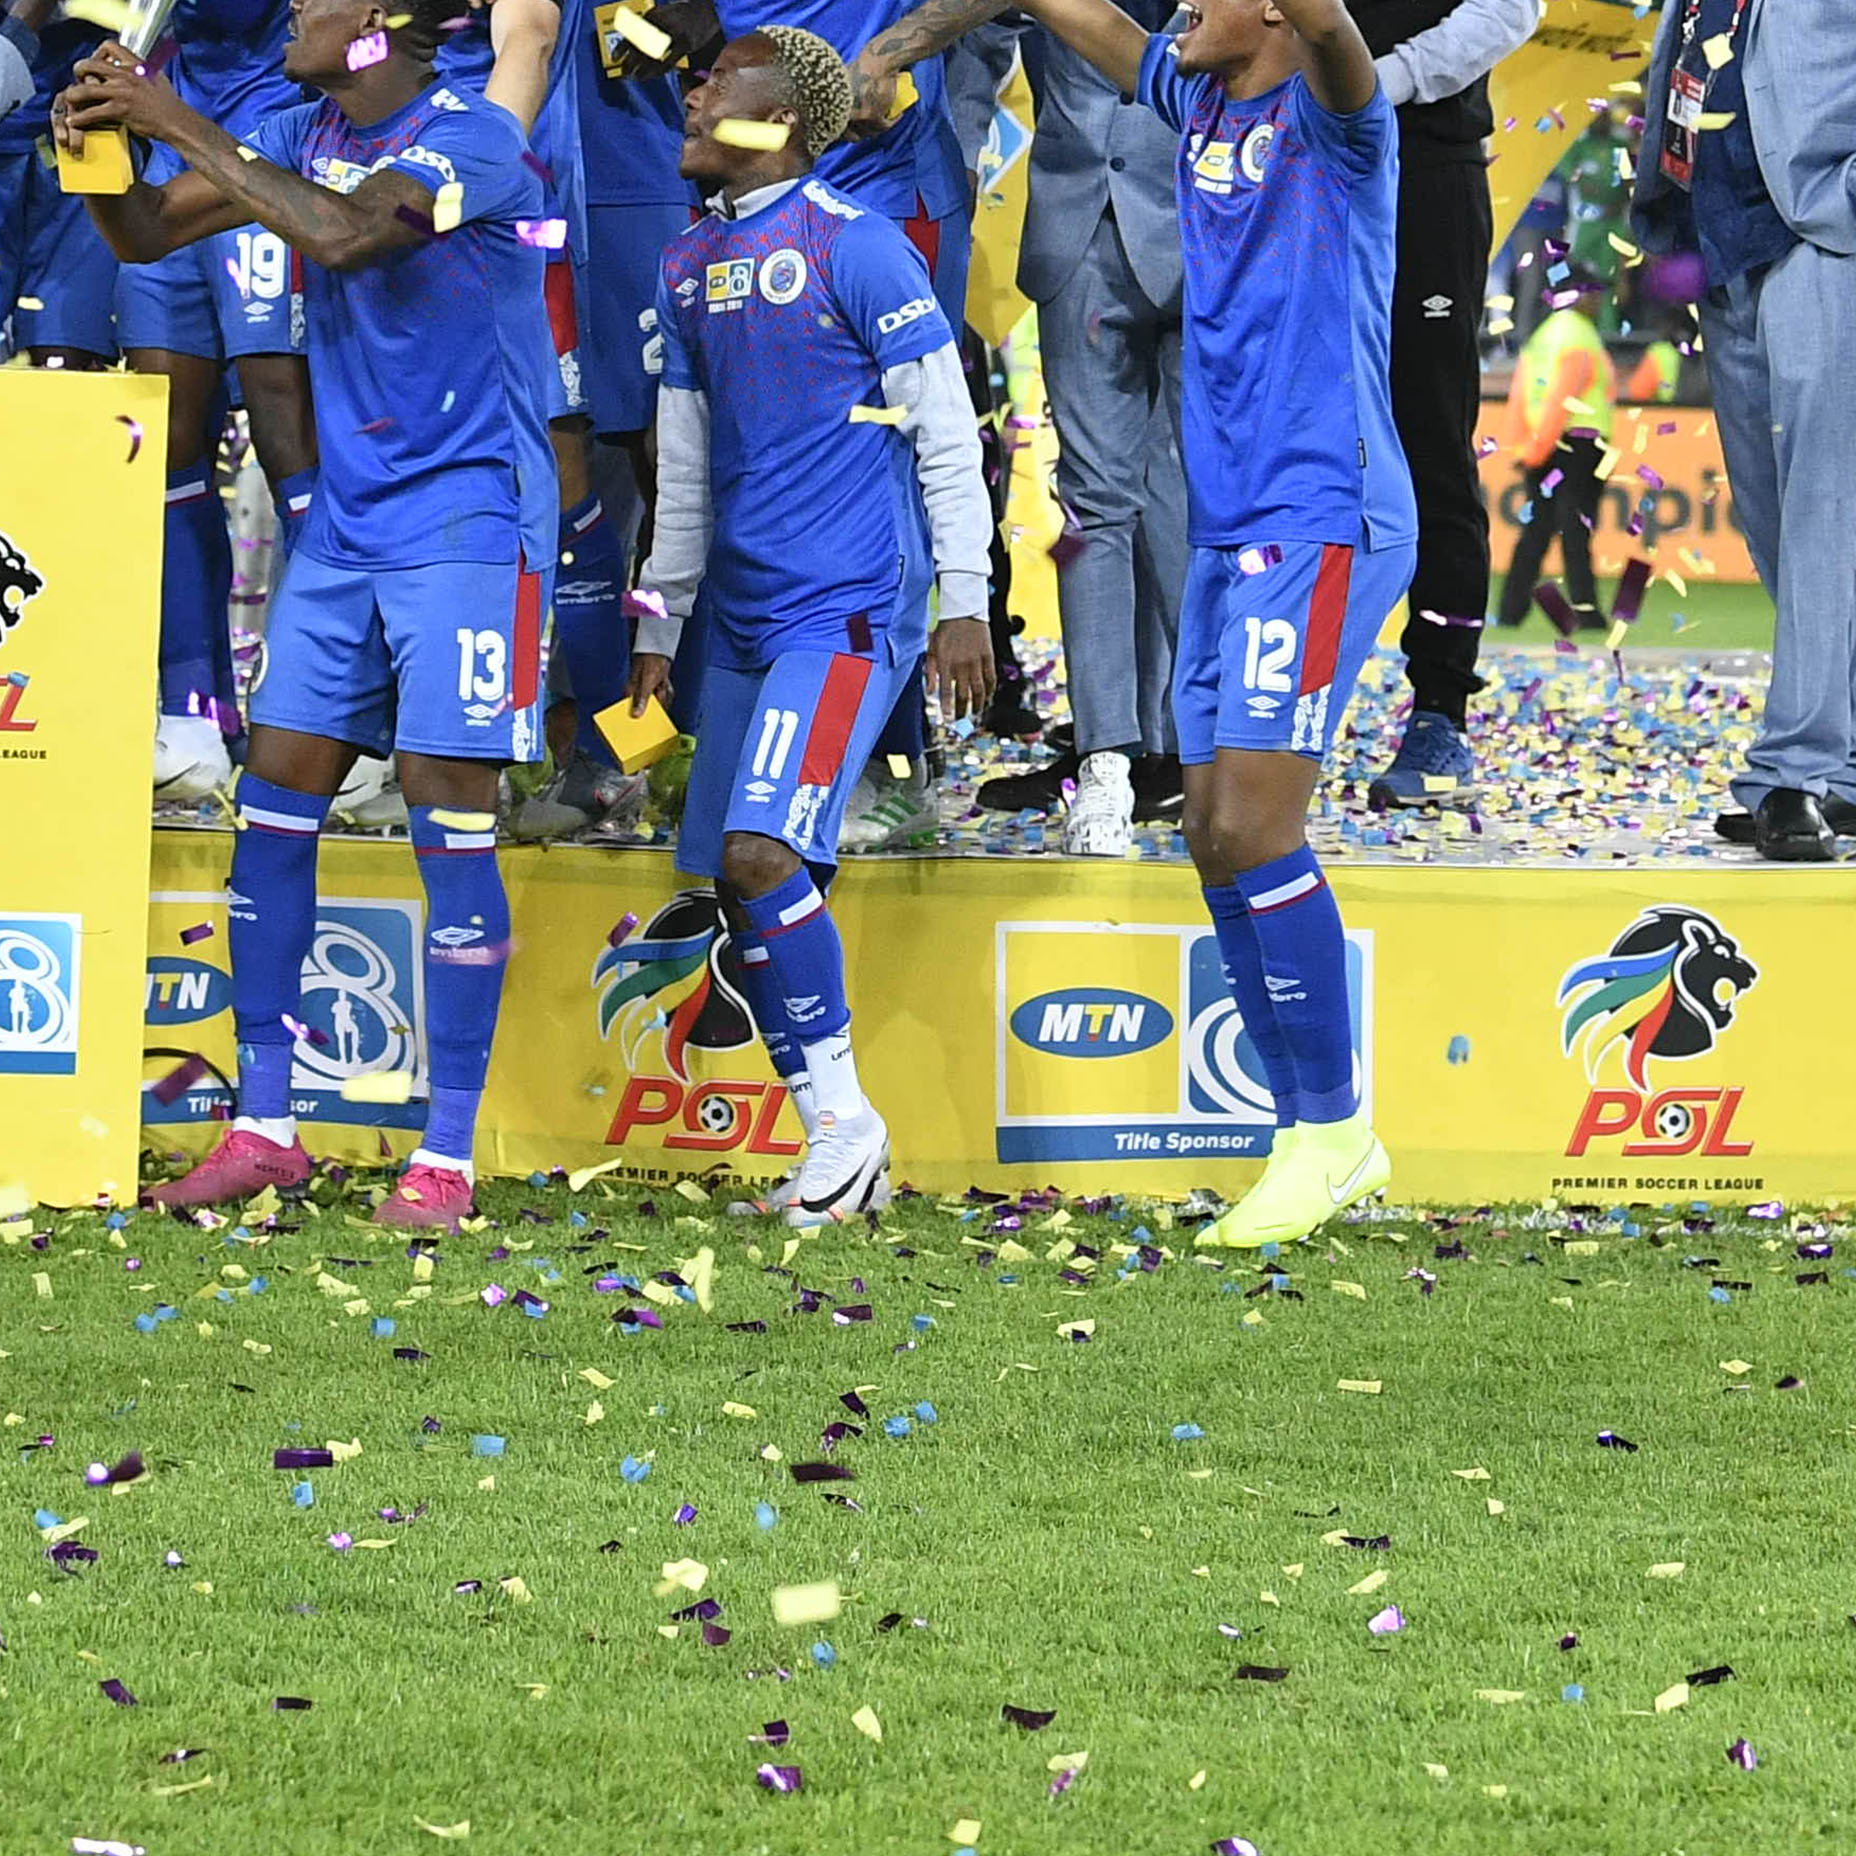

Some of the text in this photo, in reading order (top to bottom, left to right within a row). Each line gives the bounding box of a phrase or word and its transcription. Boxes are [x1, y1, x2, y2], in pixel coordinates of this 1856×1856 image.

[456, 627, 507, 702] 13
[1243, 616, 1298, 694] 12
[751, 707, 800, 780] 11
[1038, 1002, 1146, 1043] MTN
[605, 1074, 804, 1156] PSL
[1113, 1130, 1255, 1154] Title Sponsor
[1563, 1085, 1755, 1157] PSL
[1551, 1176, 1765, 1192] PREMIER SOCCER LEAGUE
